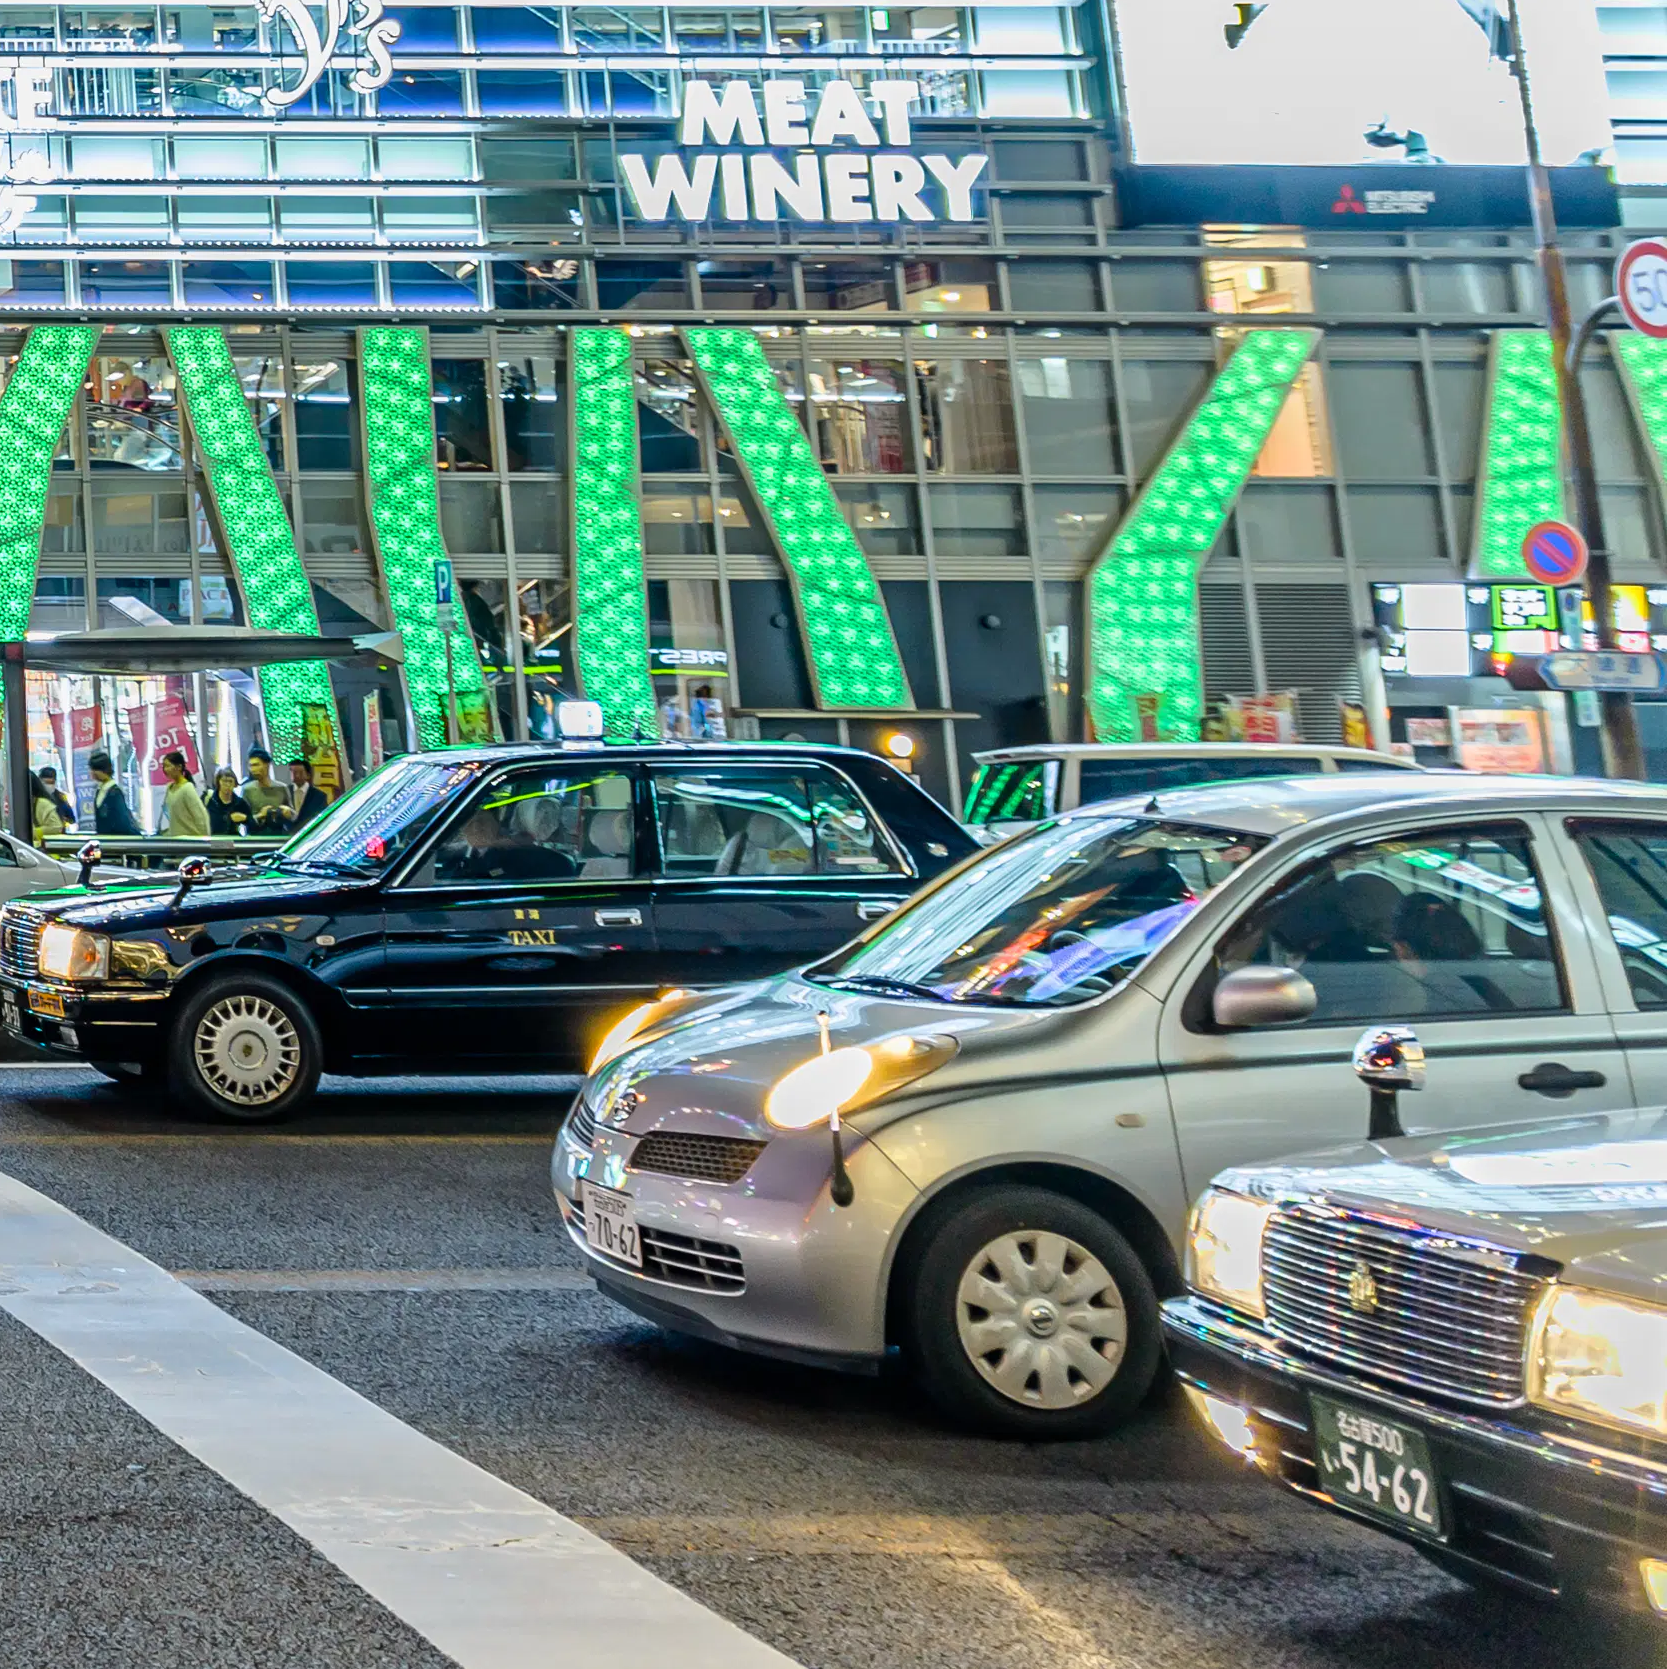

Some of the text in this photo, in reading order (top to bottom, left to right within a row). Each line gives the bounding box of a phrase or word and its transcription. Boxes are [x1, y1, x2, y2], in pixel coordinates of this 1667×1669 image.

[678, 79, 920, 148] MEAT
[619, 153, 989, 223] WINERY
[437, 564, 450, 593] P
[508, 929, 557, 946] TAXI
[594, 1212, 638, 1260] 70-62
[1339, 1441, 1433, 1524] 54-62
